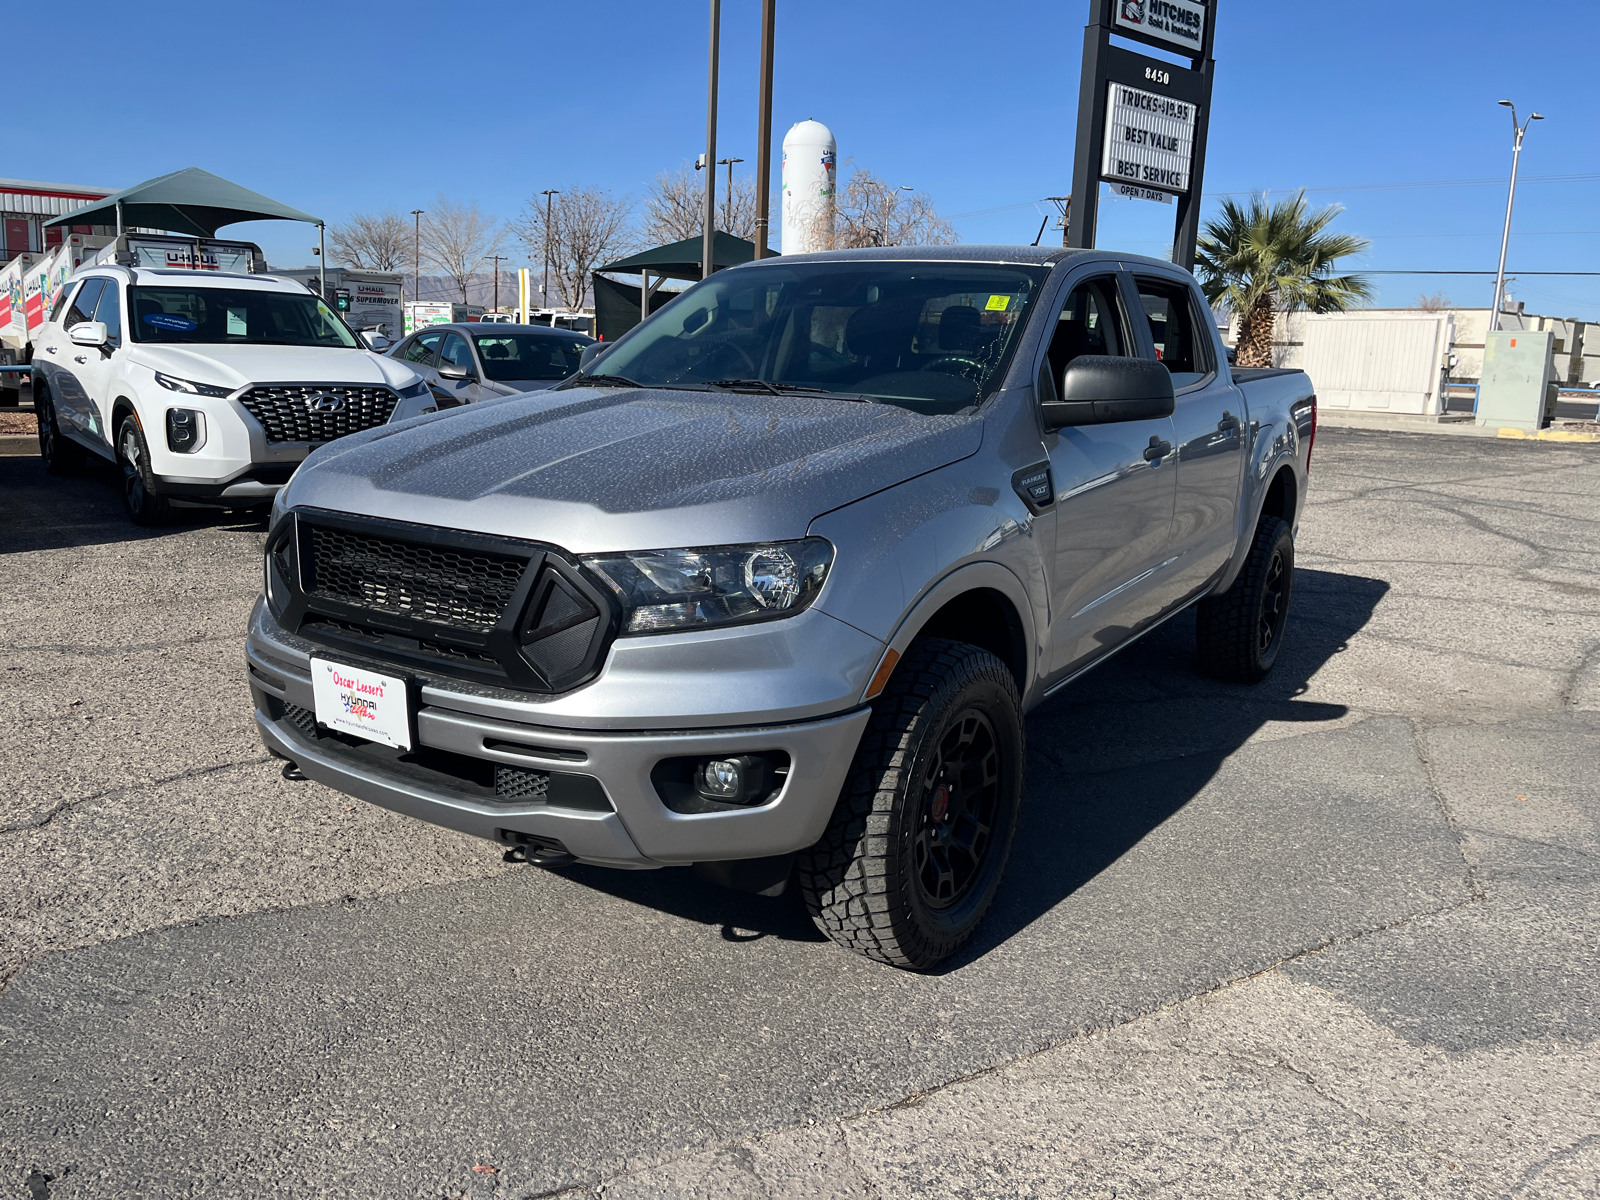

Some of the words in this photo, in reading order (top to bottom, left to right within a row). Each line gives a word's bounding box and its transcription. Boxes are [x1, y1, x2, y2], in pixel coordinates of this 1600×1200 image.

[1149, 0, 1200, 28] HITCHES
[1148, 15, 1163, 30] Sold
[1165, 20, 1170, 31] &
[1171, 23, 1199, 41] Installed
[1145, 67, 1169, 85] 8450
[1125, 126, 1148, 145] BEST
[1149, 134, 1178, 152] VALUE
[1118, 160, 1140, 178] BEST
[1143, 165, 1180, 186] SERVICE
[1120, 185, 1139, 197] OPEN
[1146, 191, 1163, 201] DAYS
[167, 253, 218, 264] U-HAUL
[356, 295, 399, 305] SUPERMOVER
[1022, 473, 1046, 485] RANGER
[1035, 486, 1047, 495] XLT
[333, 672, 354, 689] Oscar
[356, 679, 383, 697] Leeser's
[340, 693, 377, 710] HYUNDAI
